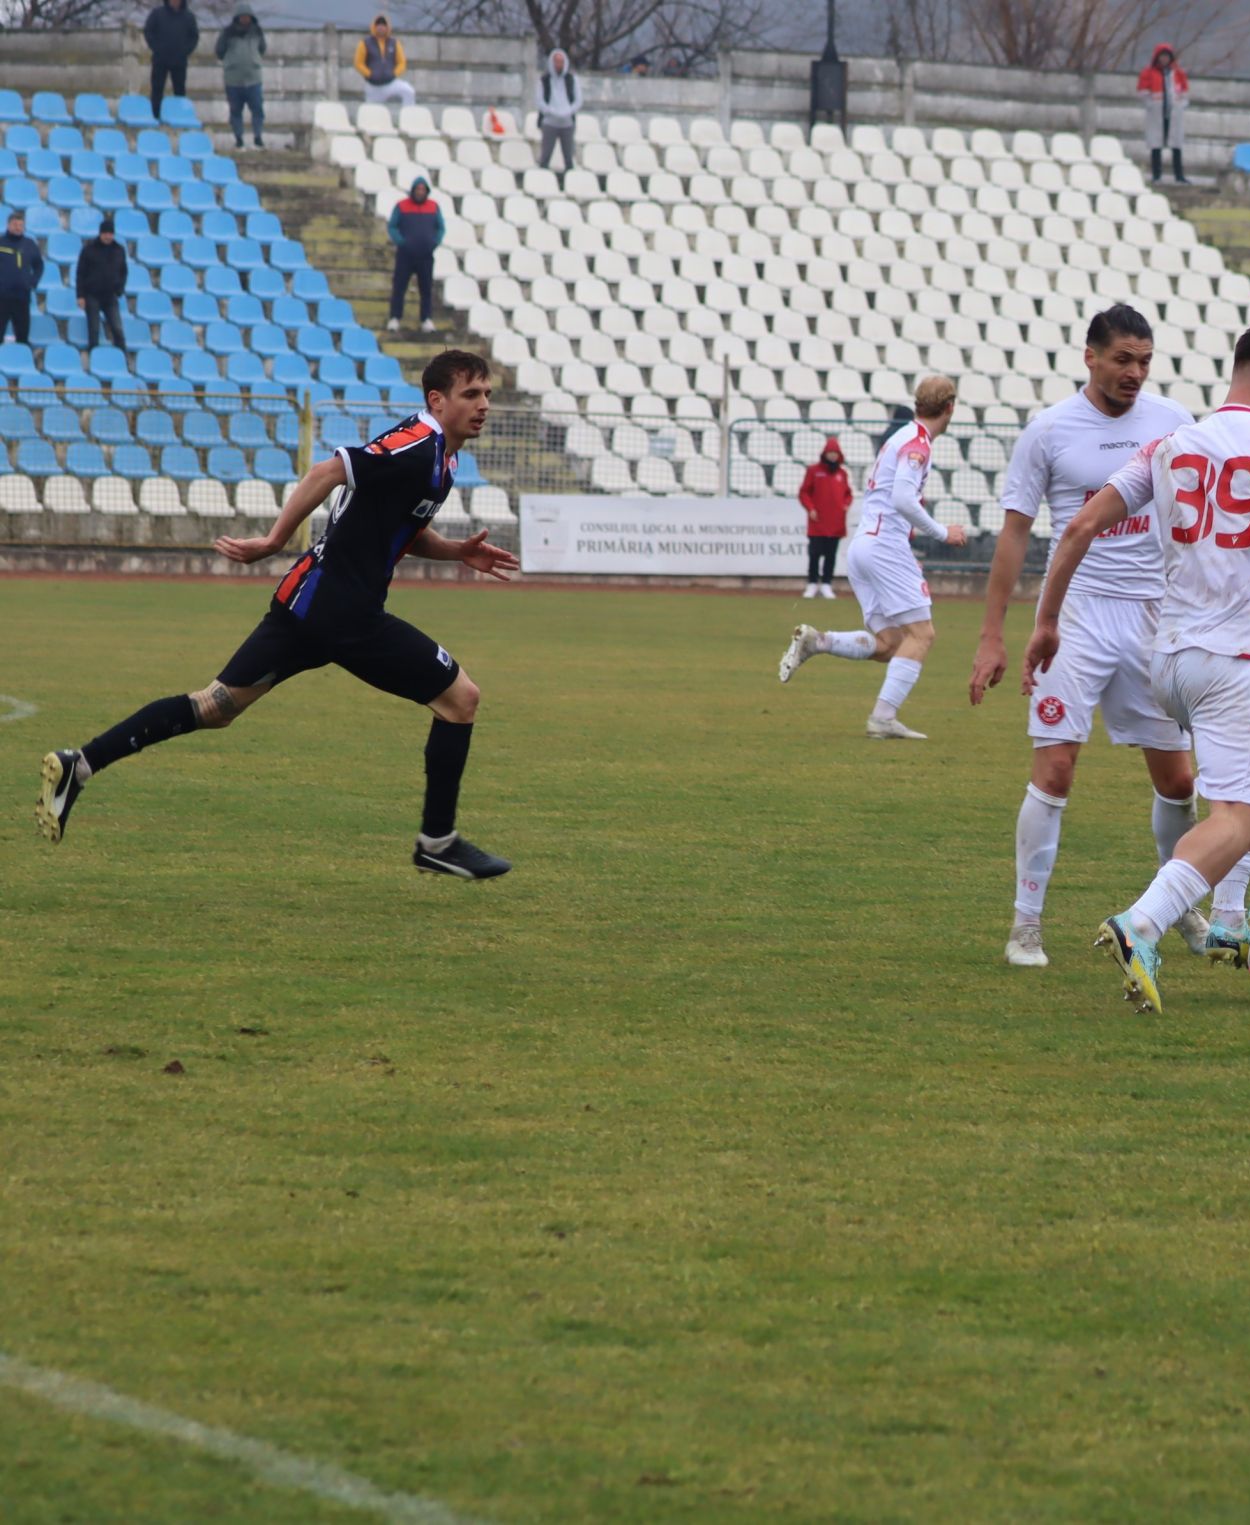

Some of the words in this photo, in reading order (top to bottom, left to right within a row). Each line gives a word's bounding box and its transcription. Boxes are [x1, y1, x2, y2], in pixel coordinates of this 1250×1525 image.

[1099, 440, 1140, 451] macron
[580, 521, 639, 534] CONSILIUL
[642, 522, 678, 535] LOCAL
[682, 523, 696, 535] AL
[576, 537, 654, 555] PRIMĂRIA
[658, 540, 764, 556] MUNICIPIULUI
